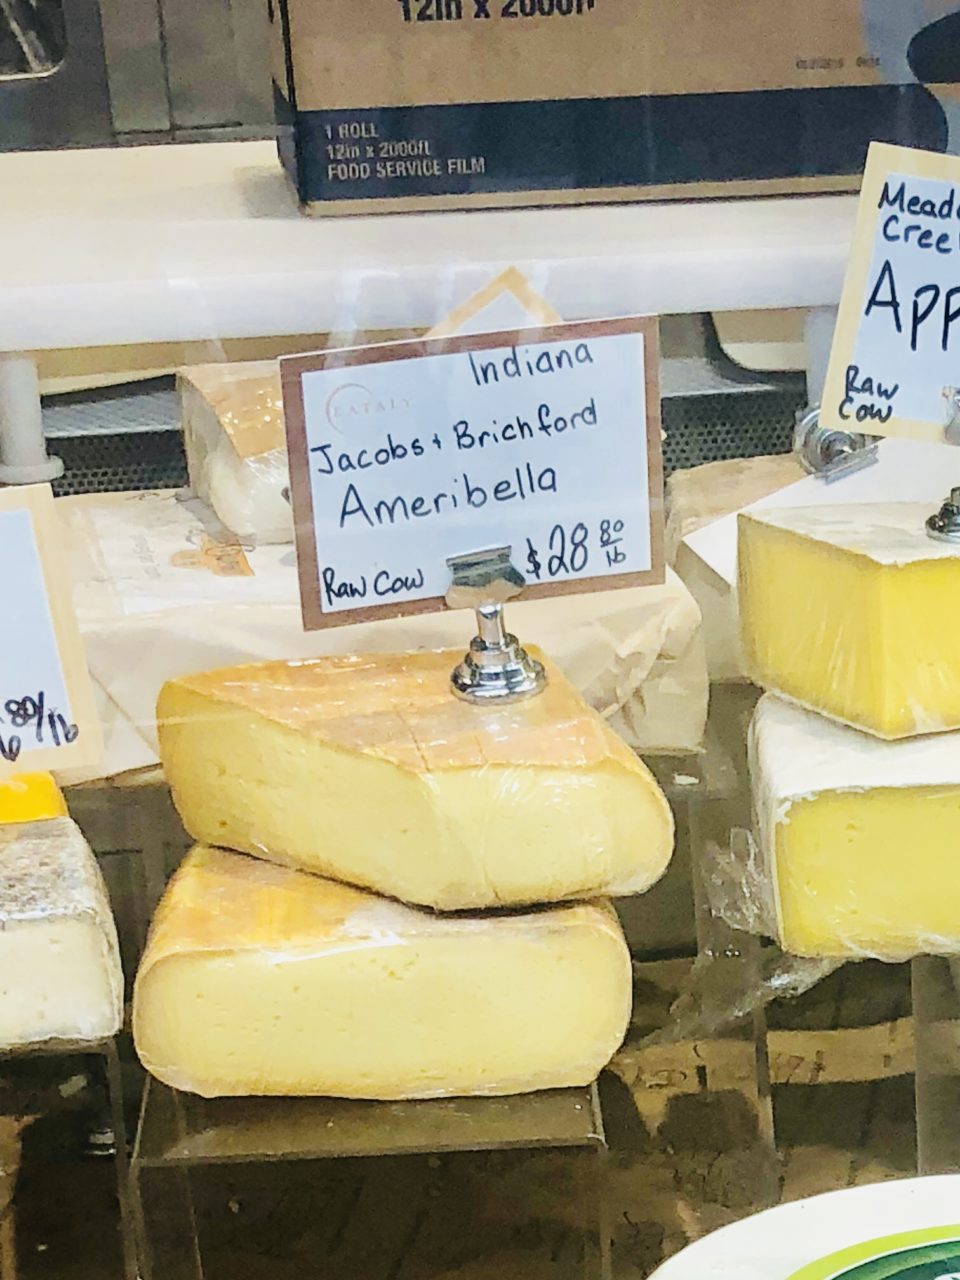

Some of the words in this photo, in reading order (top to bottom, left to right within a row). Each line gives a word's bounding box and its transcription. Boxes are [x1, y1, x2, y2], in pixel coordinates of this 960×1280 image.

[338, 122, 379, 139] ROLL
[328, 163, 370, 180] FOOD
[375, 160, 442, 178] SERVICE
[447, 157, 485, 175] FILM
[469, 343, 594, 386] Indiana
[311, 435, 425, 475] Jacobs
[453, 398, 597, 451] Brichford
[340, 462, 557, 529] Ameribella
[526, 522, 590, 580] $28
[322, 567, 368, 606] Raw
[373, 567, 424, 596] Cow
